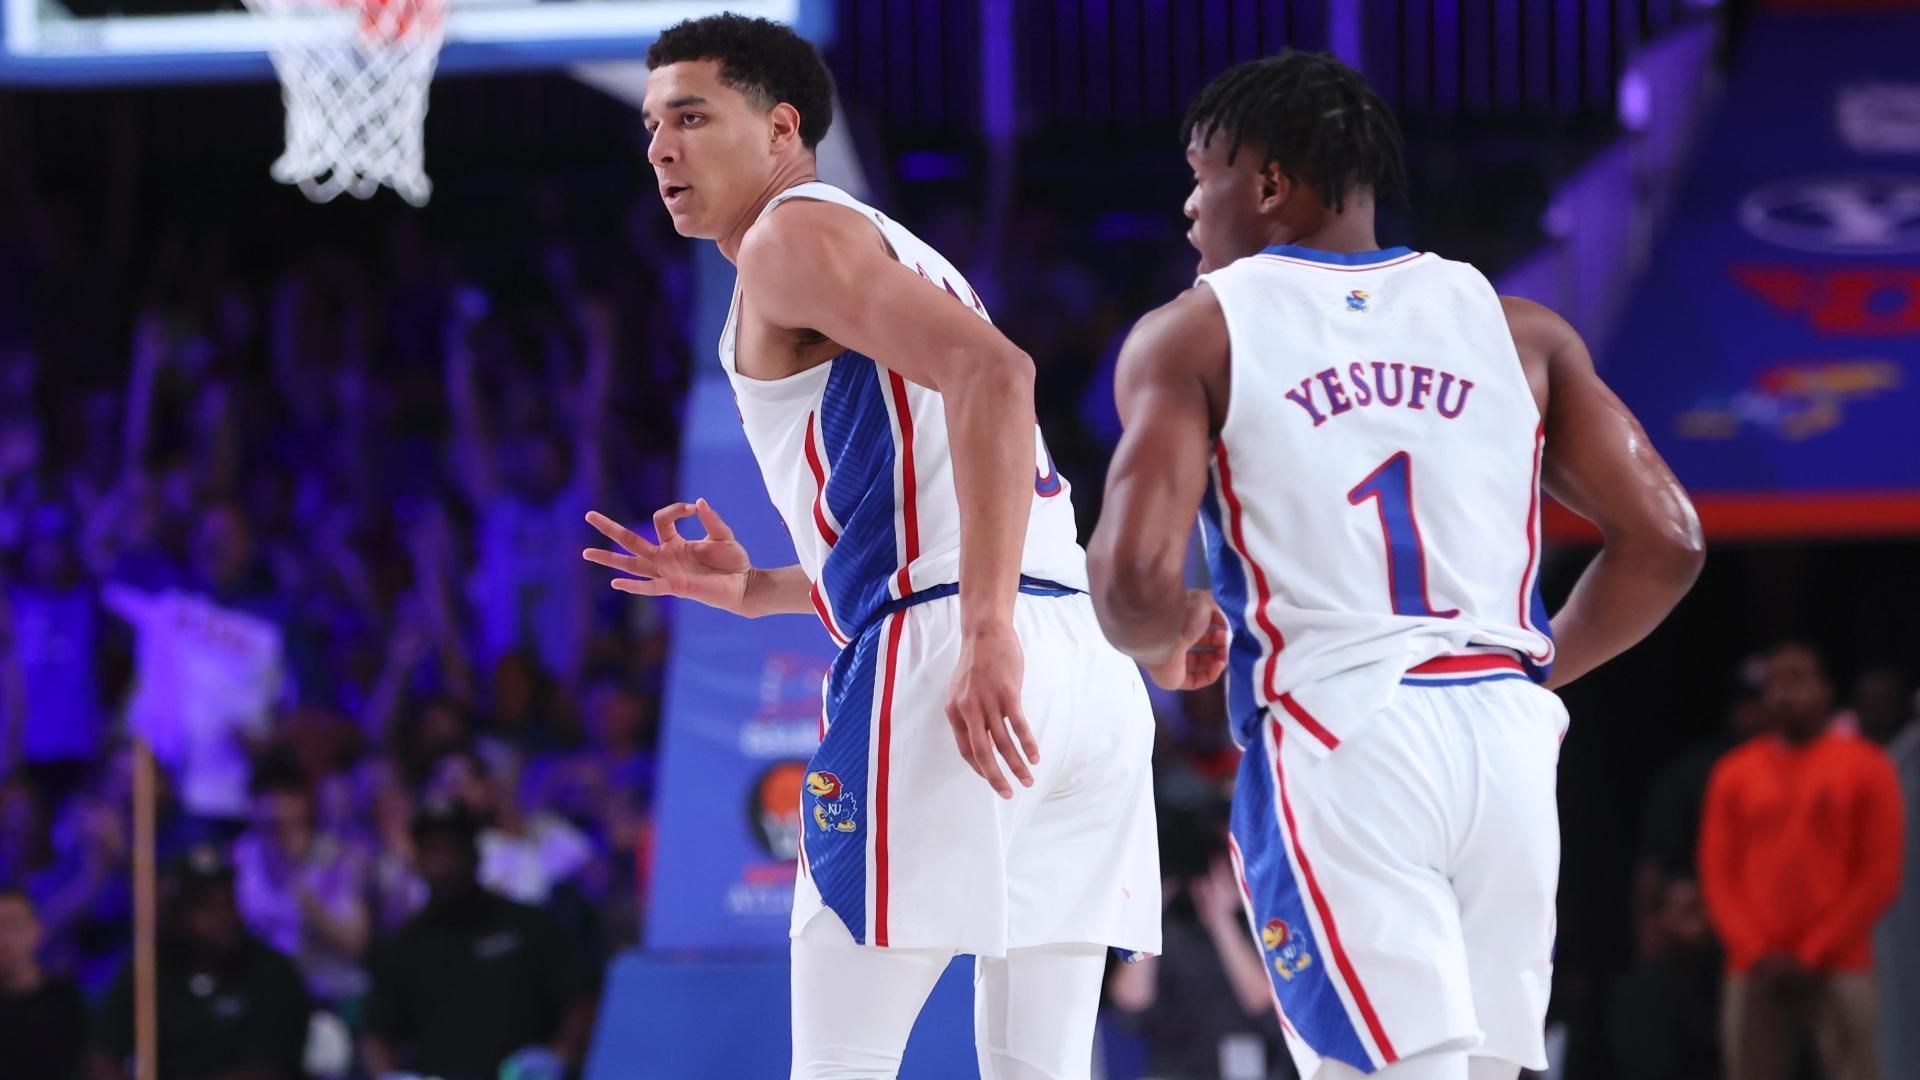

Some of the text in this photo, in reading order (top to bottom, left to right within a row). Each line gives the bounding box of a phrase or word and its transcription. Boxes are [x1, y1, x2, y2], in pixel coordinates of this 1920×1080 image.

[1285, 361, 1474, 427] YESUFU
[1347, 450, 1460, 618] 1
[828, 803, 842, 816] KU
